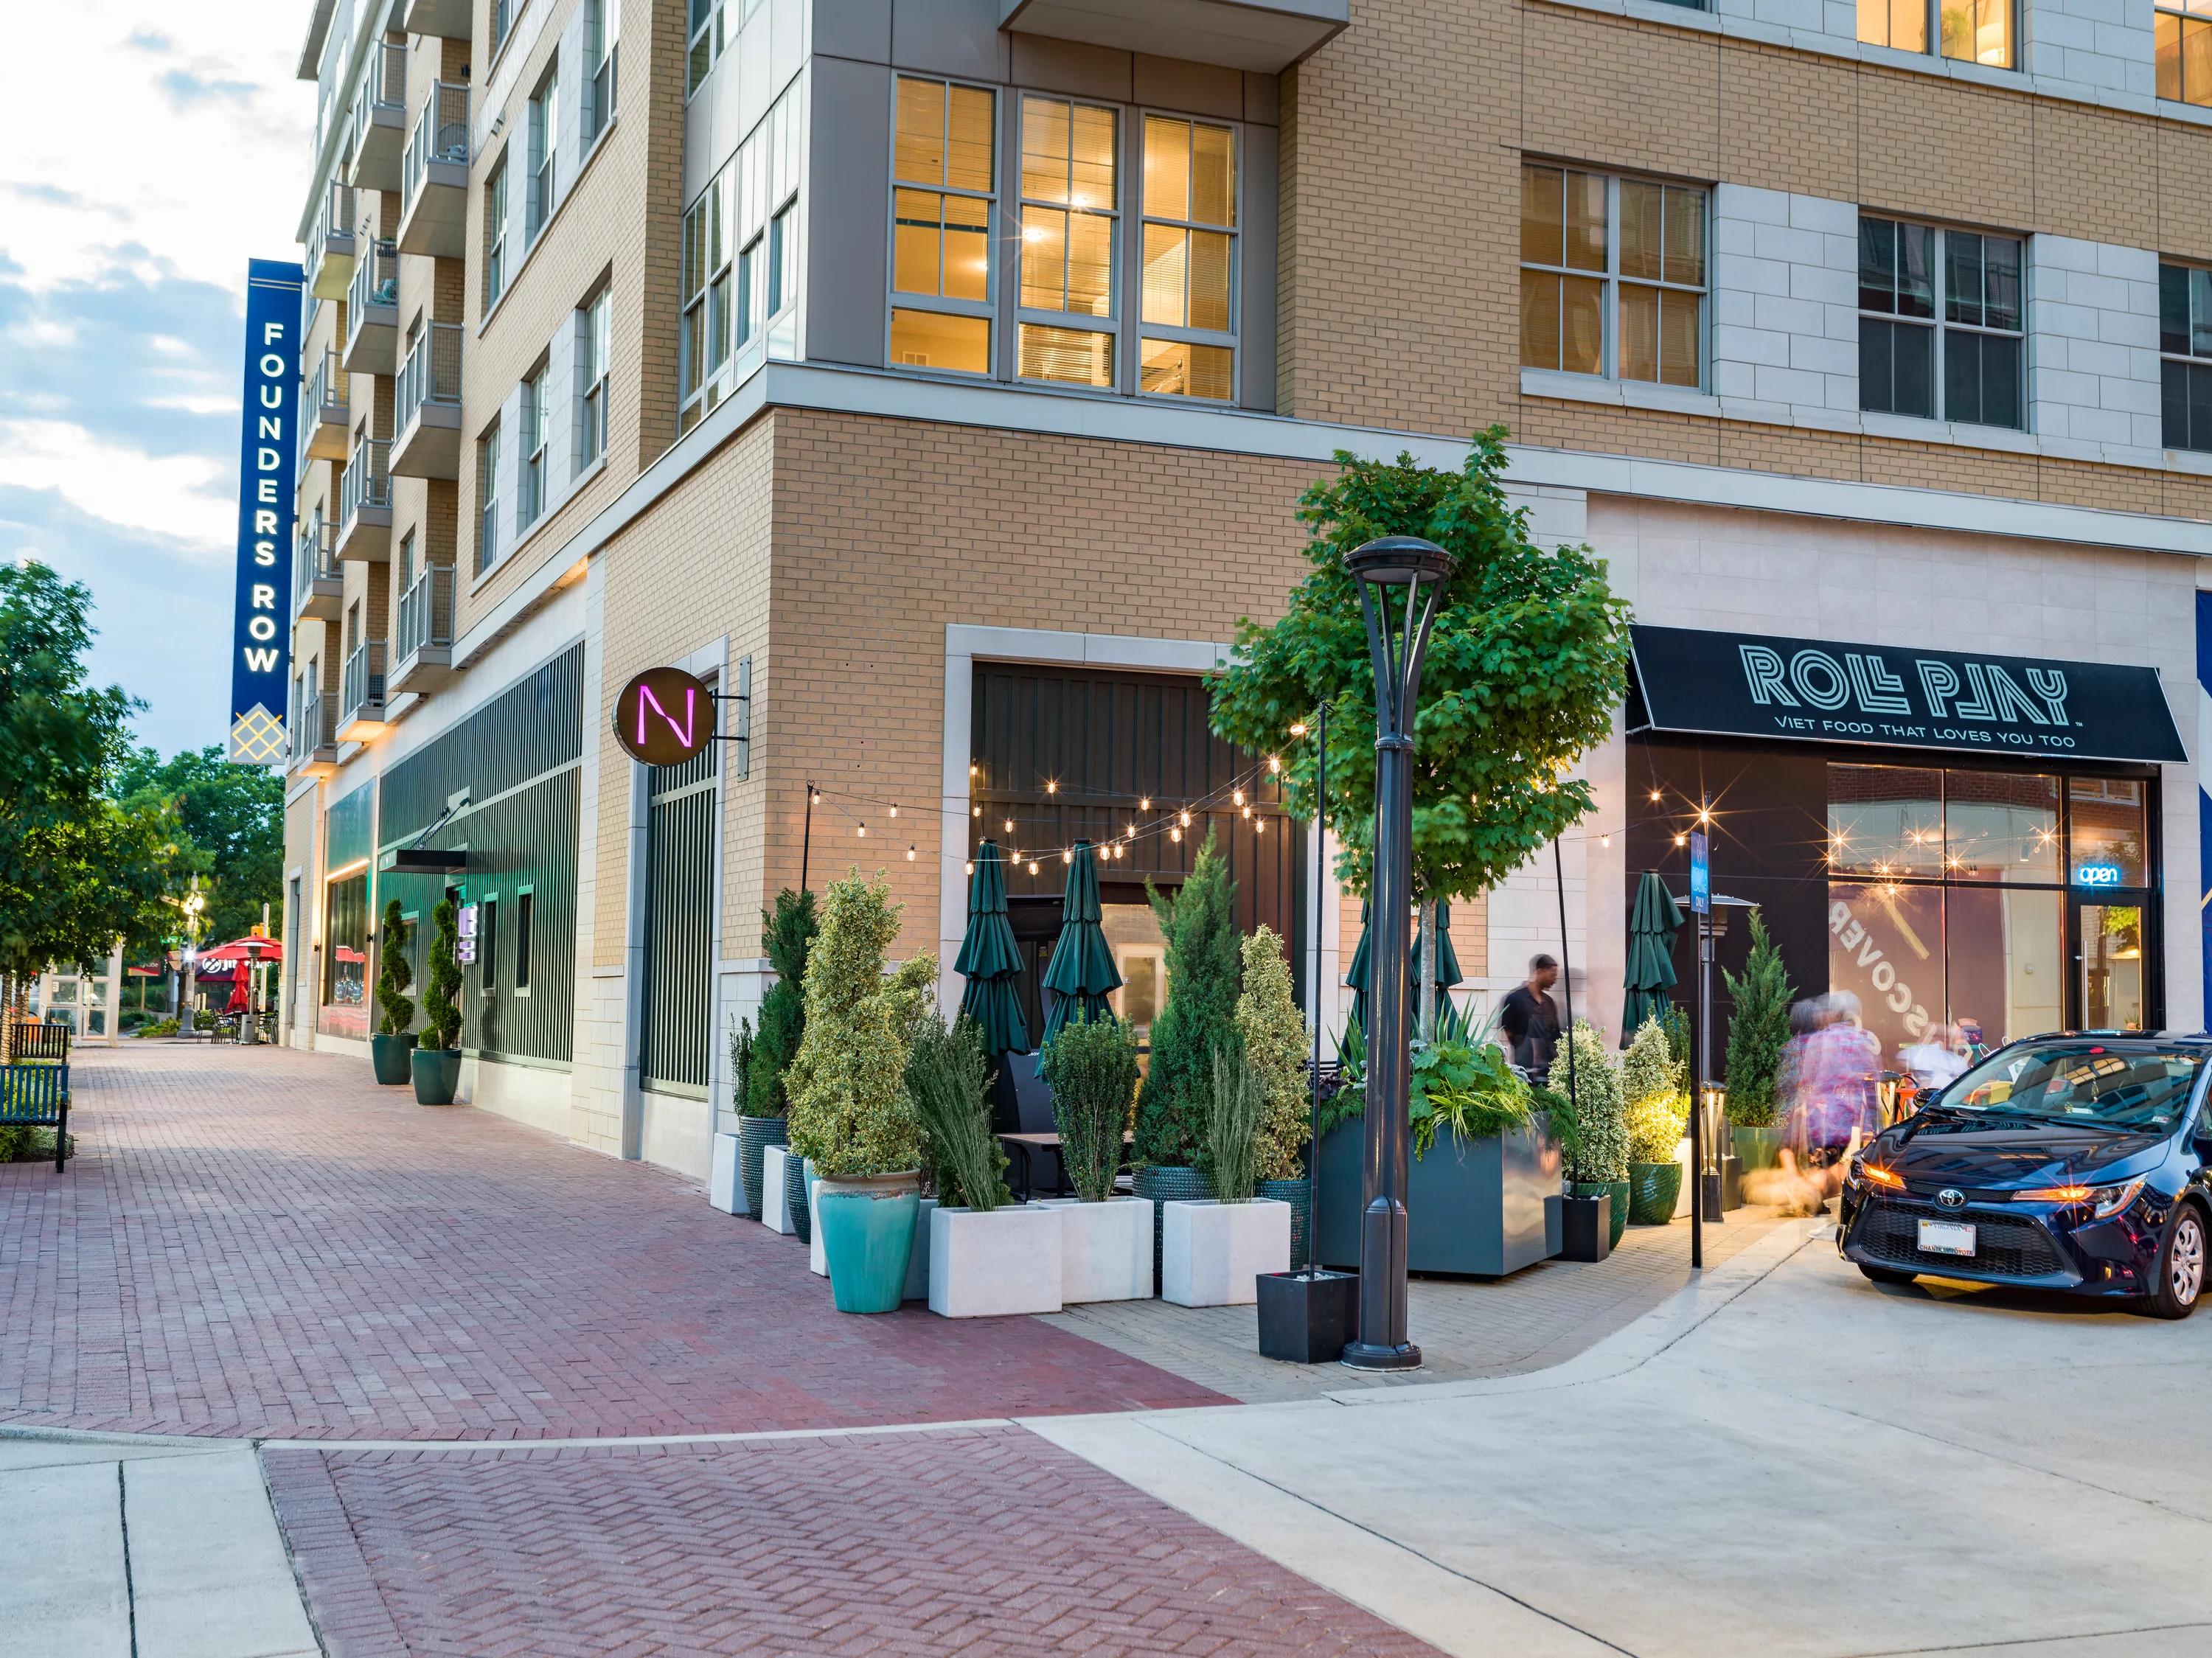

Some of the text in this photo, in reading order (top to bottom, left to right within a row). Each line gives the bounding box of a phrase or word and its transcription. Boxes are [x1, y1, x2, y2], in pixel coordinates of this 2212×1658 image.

[244, 322, 285, 672] FOUNDERS ROW
[1738, 644, 1912, 715] ROLL
[637, 685, 695, 748] N
[1775, 716, 2076, 748] VIET FOOD THAT LOVES YOU TOO
[2079, 867, 2118, 885] open
